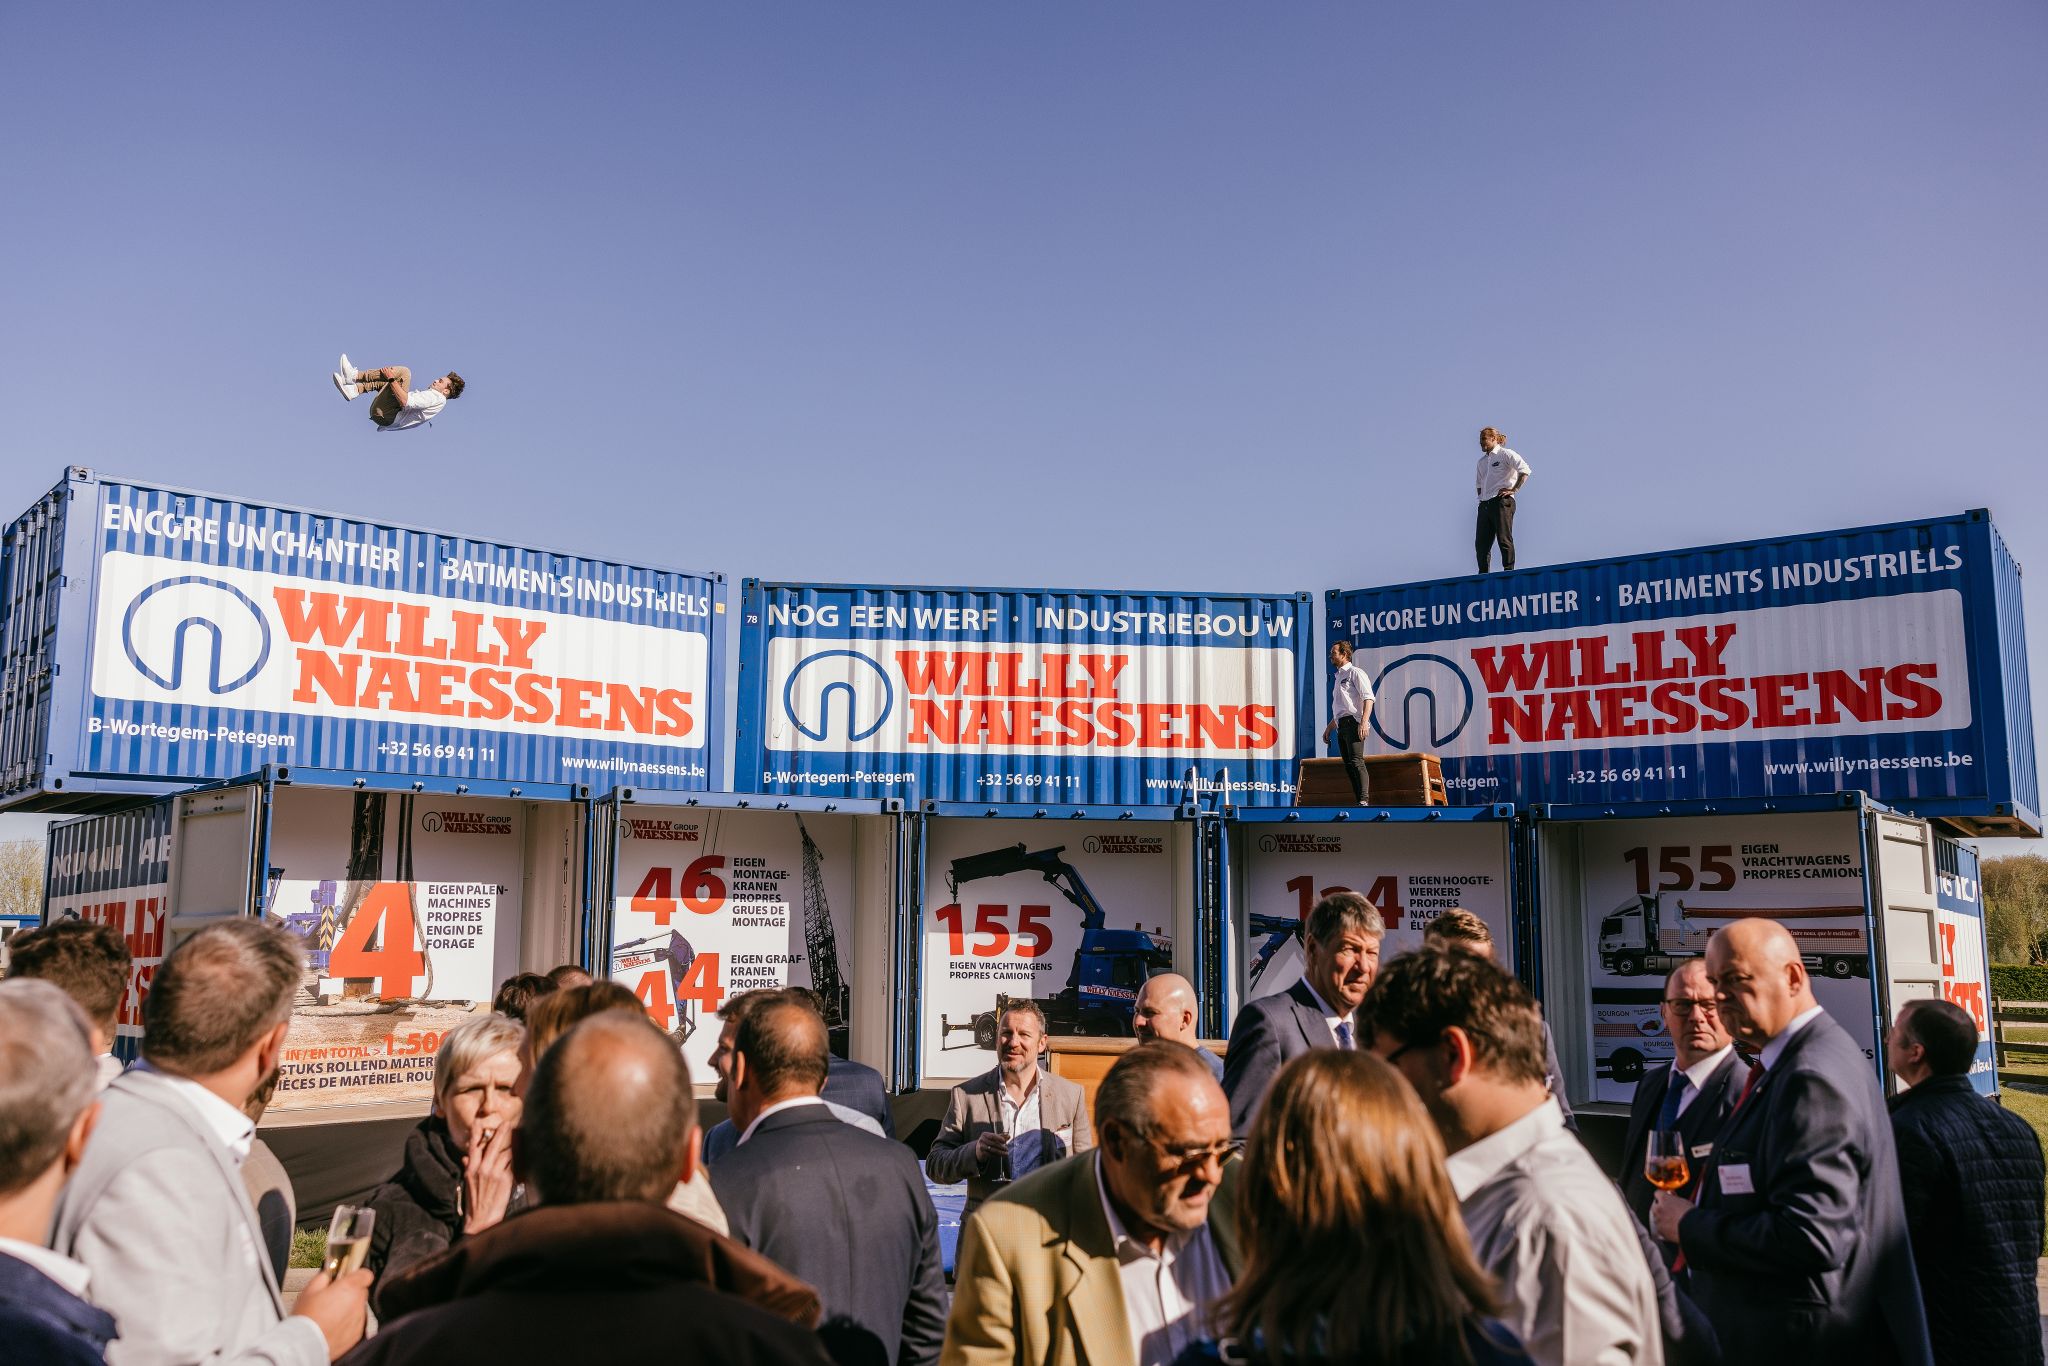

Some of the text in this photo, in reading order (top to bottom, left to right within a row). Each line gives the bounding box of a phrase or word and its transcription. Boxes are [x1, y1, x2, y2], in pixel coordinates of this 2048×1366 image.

[103, 503, 219, 545] ENCORE
[227, 522, 267, 551] UN
[271, 530, 401, 572] CHANTIER
[1618, 545, 1963, 607] BATIMENTS INDUSTRIELS
[442, 557, 709, 617] BATIMENTS INDUSTRIELS
[768, 604, 998, 631] NOG EEN WERF
[1350, 589, 1579, 635] ENCORE UN CHANTIER
[746, 615, 758, 624] 78
[1332, 619, 1342, 628] 76
[273, 586, 546, 669] WILLY
[1470, 623, 1737, 693] WILLY
[895, 650, 1128, 699] WILLY
[293, 648, 694, 738] NAESSENS
[1488, 663, 1943, 745] NAESSENS
[907, 699, 1279, 750] NAESSENS
[88, 717, 295, 748] B-Wortegem-Petegem
[378, 741, 495, 762] +32 56 69 41 11
[562, 756, 705, 777] www.willynaessens.be
[1764, 751, 1973, 775] www.willynaessens.be
[763, 771, 915, 787] B-Wortegem-Petegem
[1567, 765, 1686, 784] +32 56 69 41 11
[976, 774, 1080, 788] +32 56 69 41 11
[441, 811, 512, 824] WILLY GROUP
[443, 823, 512, 834] NAESSENS
[631, 819, 699, 831] WILLY GROUP
[633, 829, 699, 842] NAESSENS
[1099, 835, 1137, 845] WILLY
[1275, 834, 1315, 843] WILLY
[1102, 844, 1163, 854] NAESSENS
[1279, 843, 1342, 853] NAESSENS
[1741, 843, 1779, 854] EIGEN
[733, 857, 766, 867] EIGEN
[1742, 854, 1851, 867] VRACHTWAGENS
[733, 869, 790, 880] MONTAGE-
[1623, 845, 1736, 894] 155
[1743, 867, 1865, 880] PROPRES CAMIONS
[733, 881, 777, 891] KRANEN
[1409, 876, 1494, 885] EIGEN HOOGTE-
[428, 884, 508, 895] EIGEN PALEN-
[631, 855, 727, 925] 46
[1409, 887, 1461, 896] WERKERS
[427, 898, 491, 908] MACHINES
[732, 893, 782, 903] PROPRES
[1286, 875, 1404, 929] 14
[1409, 898, 1459, 908] PROPRES
[732, 905, 785, 915] GRUES DE
[427, 911, 482, 922] PROPRES
[732, 917, 786, 927] MONTAGE
[426, 925, 483, 936] ENGIN DE
[935, 904, 1053, 957] 155
[329, 883, 425, 1000] 4
[425, 939, 475, 949] FORAGE
[731, 954, 806, 964] EIGEN GRAAF-
[730, 967, 775, 976] KRANEN
[950, 962, 1053, 971] EIGEN VRACHTWAGENS
[993, 972, 1036, 980] CAMIONS
[730, 979, 779, 988] PROPRES
[331, 1046, 371, 1058] TOTAL
[326, 1059, 388, 1073] ROLLEND
[390, 1057, 438, 1069] MATER
[278, 1077, 316, 1091] IÈCES
[319, 1077, 337, 1088] DE
[340, 1072, 404, 1087] MATÉRIEL
